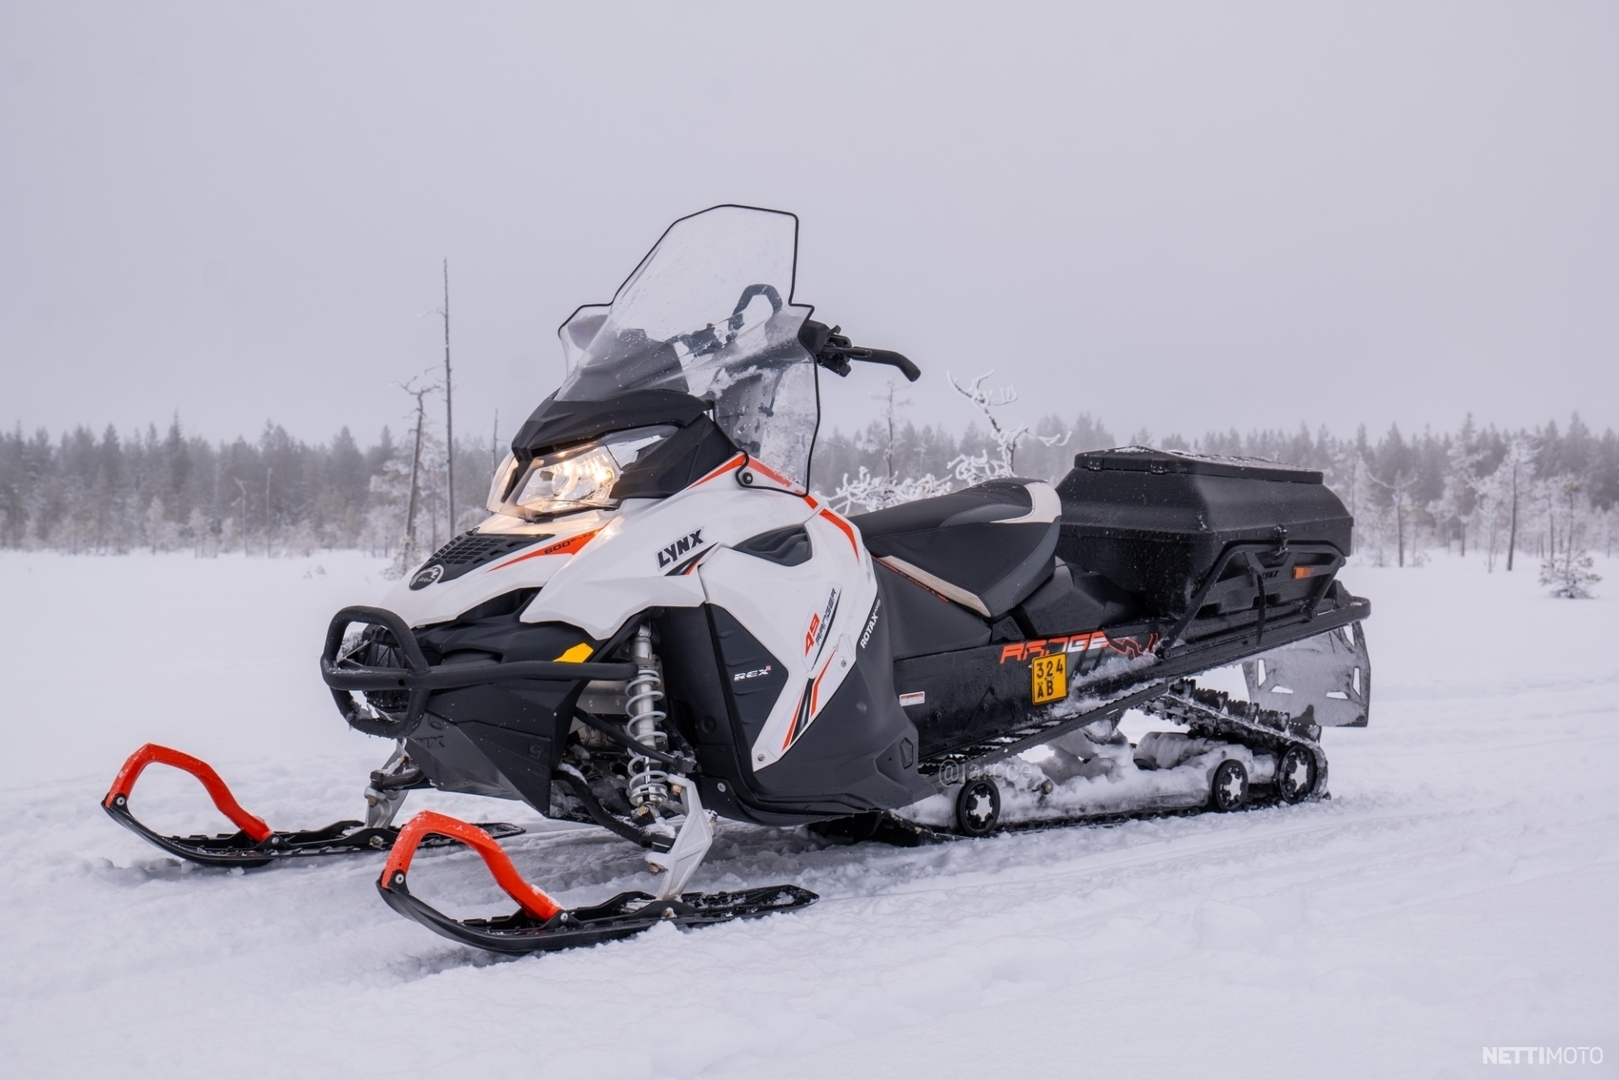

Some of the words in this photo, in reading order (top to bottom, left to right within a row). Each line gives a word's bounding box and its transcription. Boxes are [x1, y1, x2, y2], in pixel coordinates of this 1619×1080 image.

[544, 540, 571, 554] 600
[657, 529, 704, 569] LYNX
[804, 612, 821, 658] 49
[815, 587, 837, 646] RANGER
[860, 612, 879, 649] ROTAX
[1036, 658, 1064, 679] 324
[1036, 680, 1054, 699] ÄB
